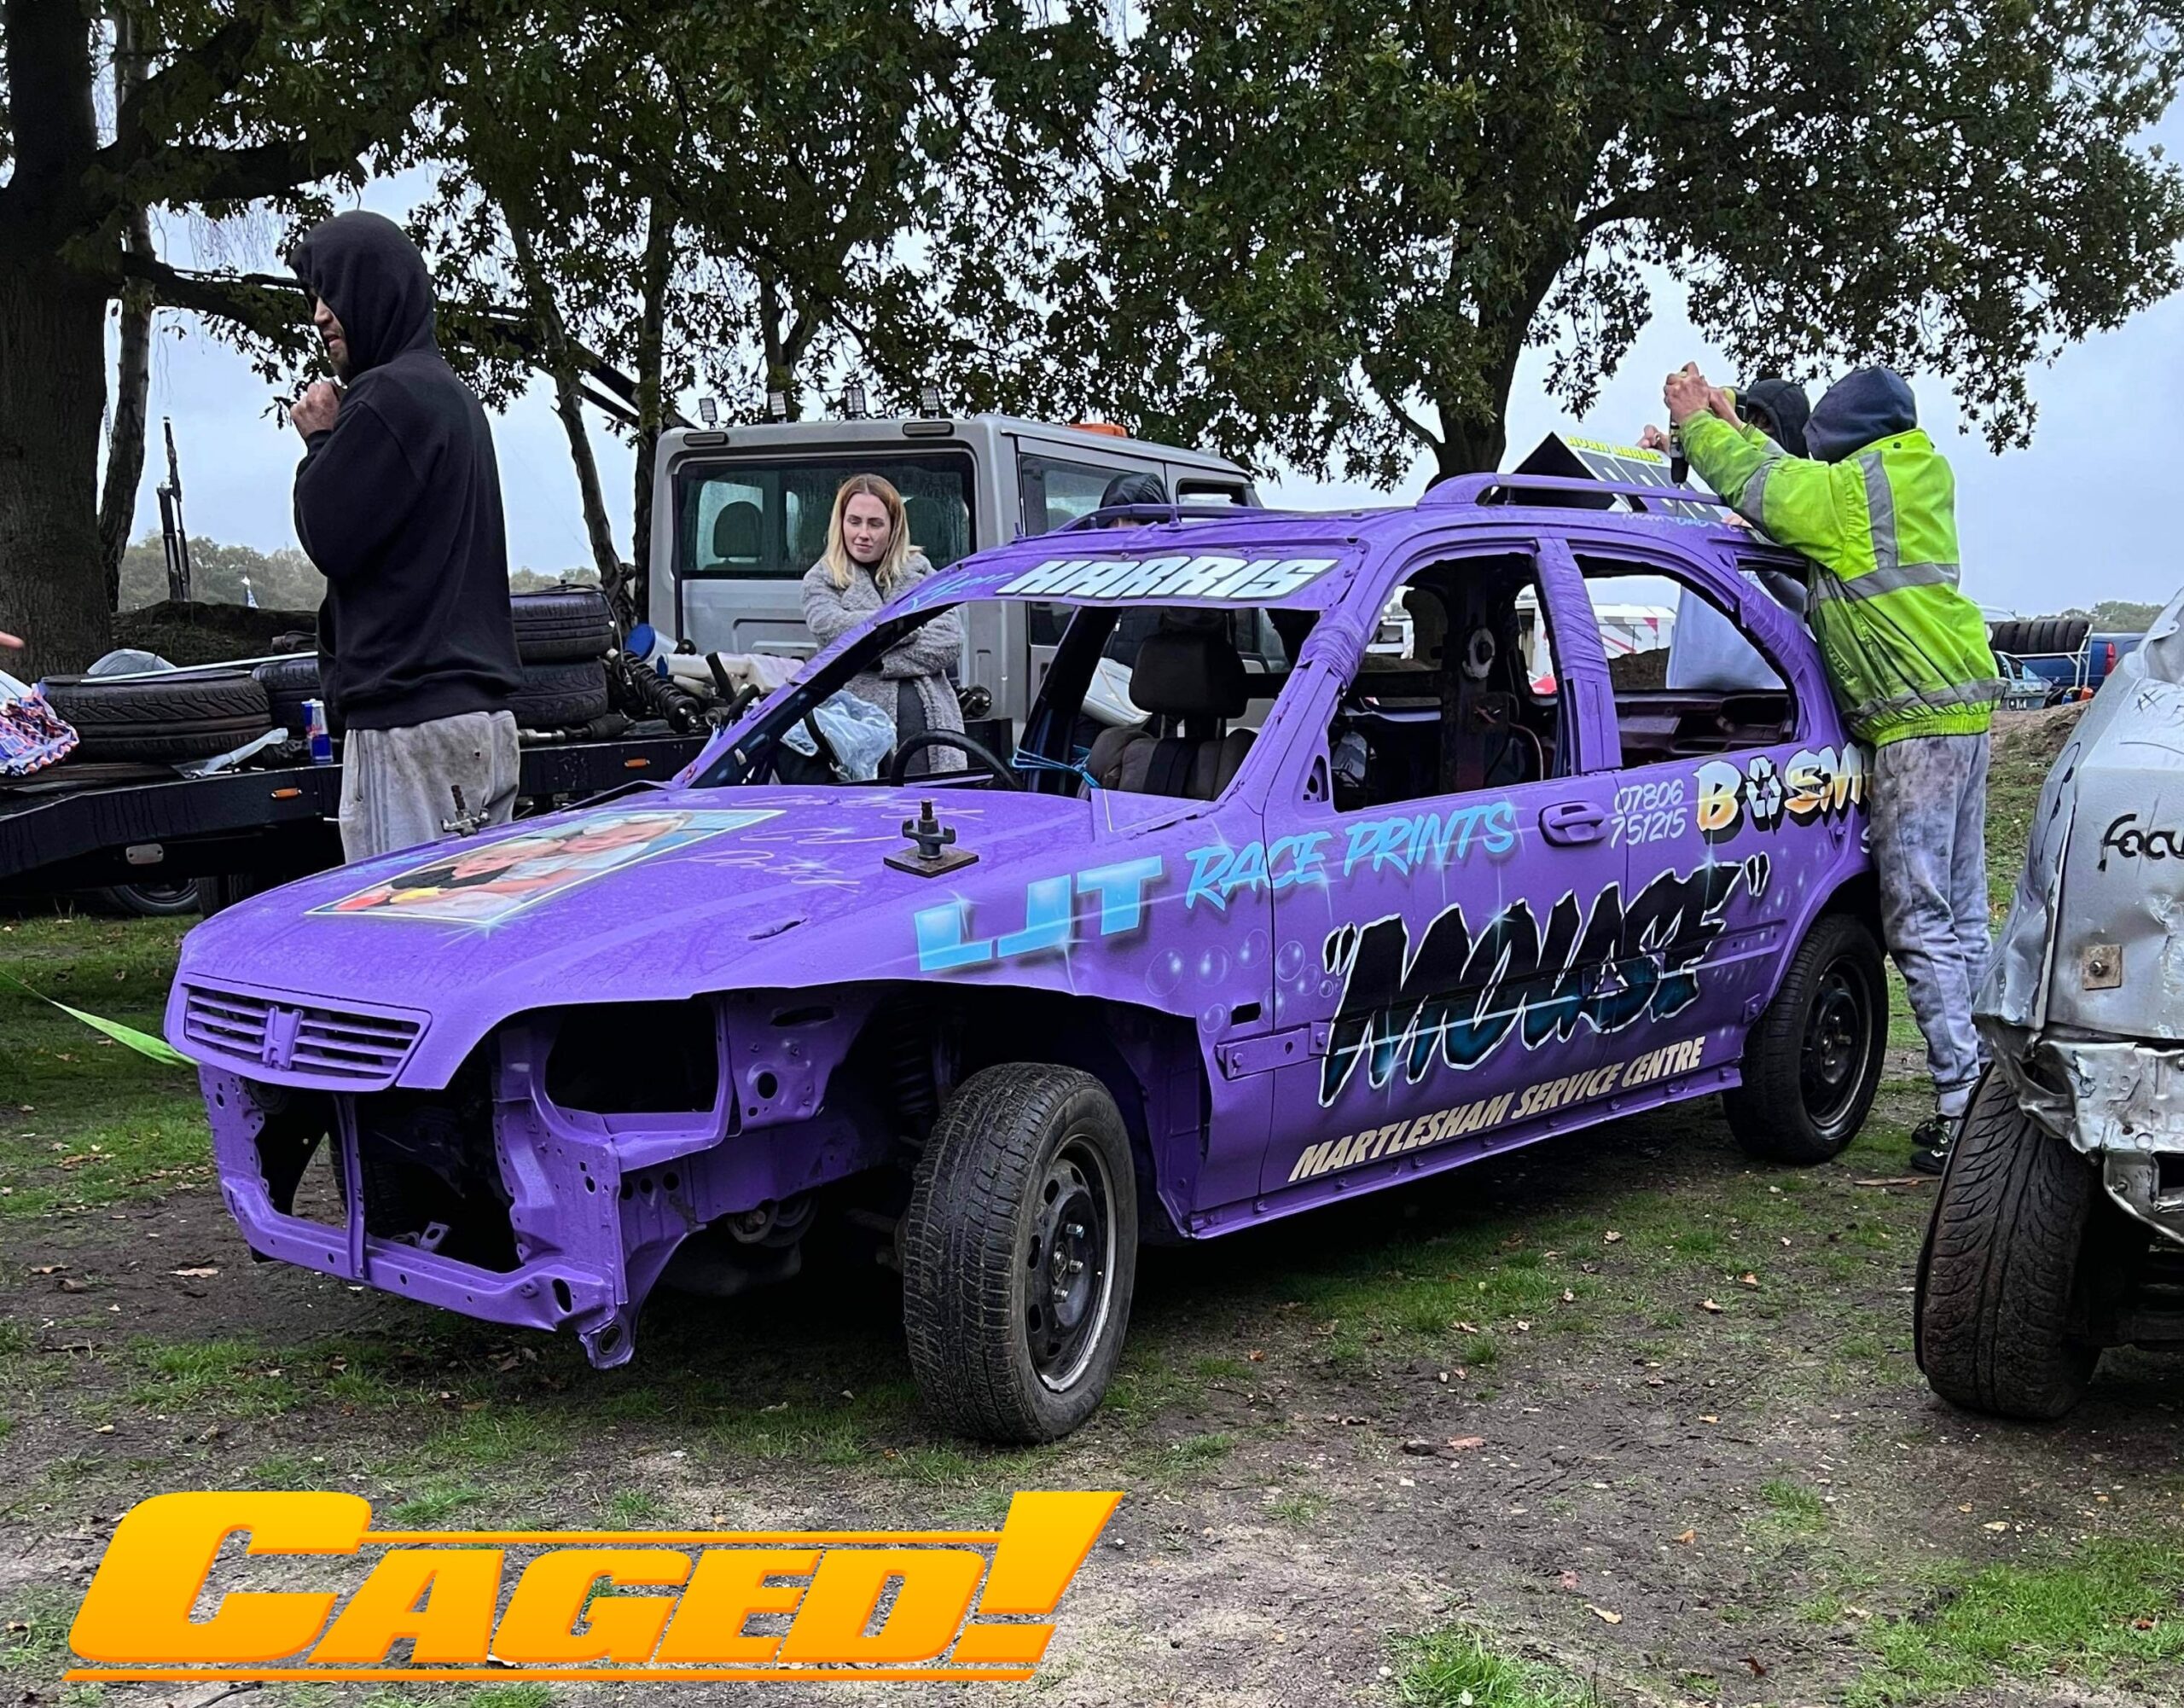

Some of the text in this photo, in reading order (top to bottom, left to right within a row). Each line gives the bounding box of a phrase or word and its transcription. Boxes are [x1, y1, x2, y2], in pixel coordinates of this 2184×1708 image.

[996, 555, 1339, 600] HARRIS
[1611, 807, 1687, 849] 751215
[1614, 778, 1684, 815] 07806
[1185, 802, 1515, 910] RACE PRINTS
[914, 856, 1162, 972] LJT
[1287, 1035, 1707, 1183] MARTLESHAM SERVICE CENTRE
